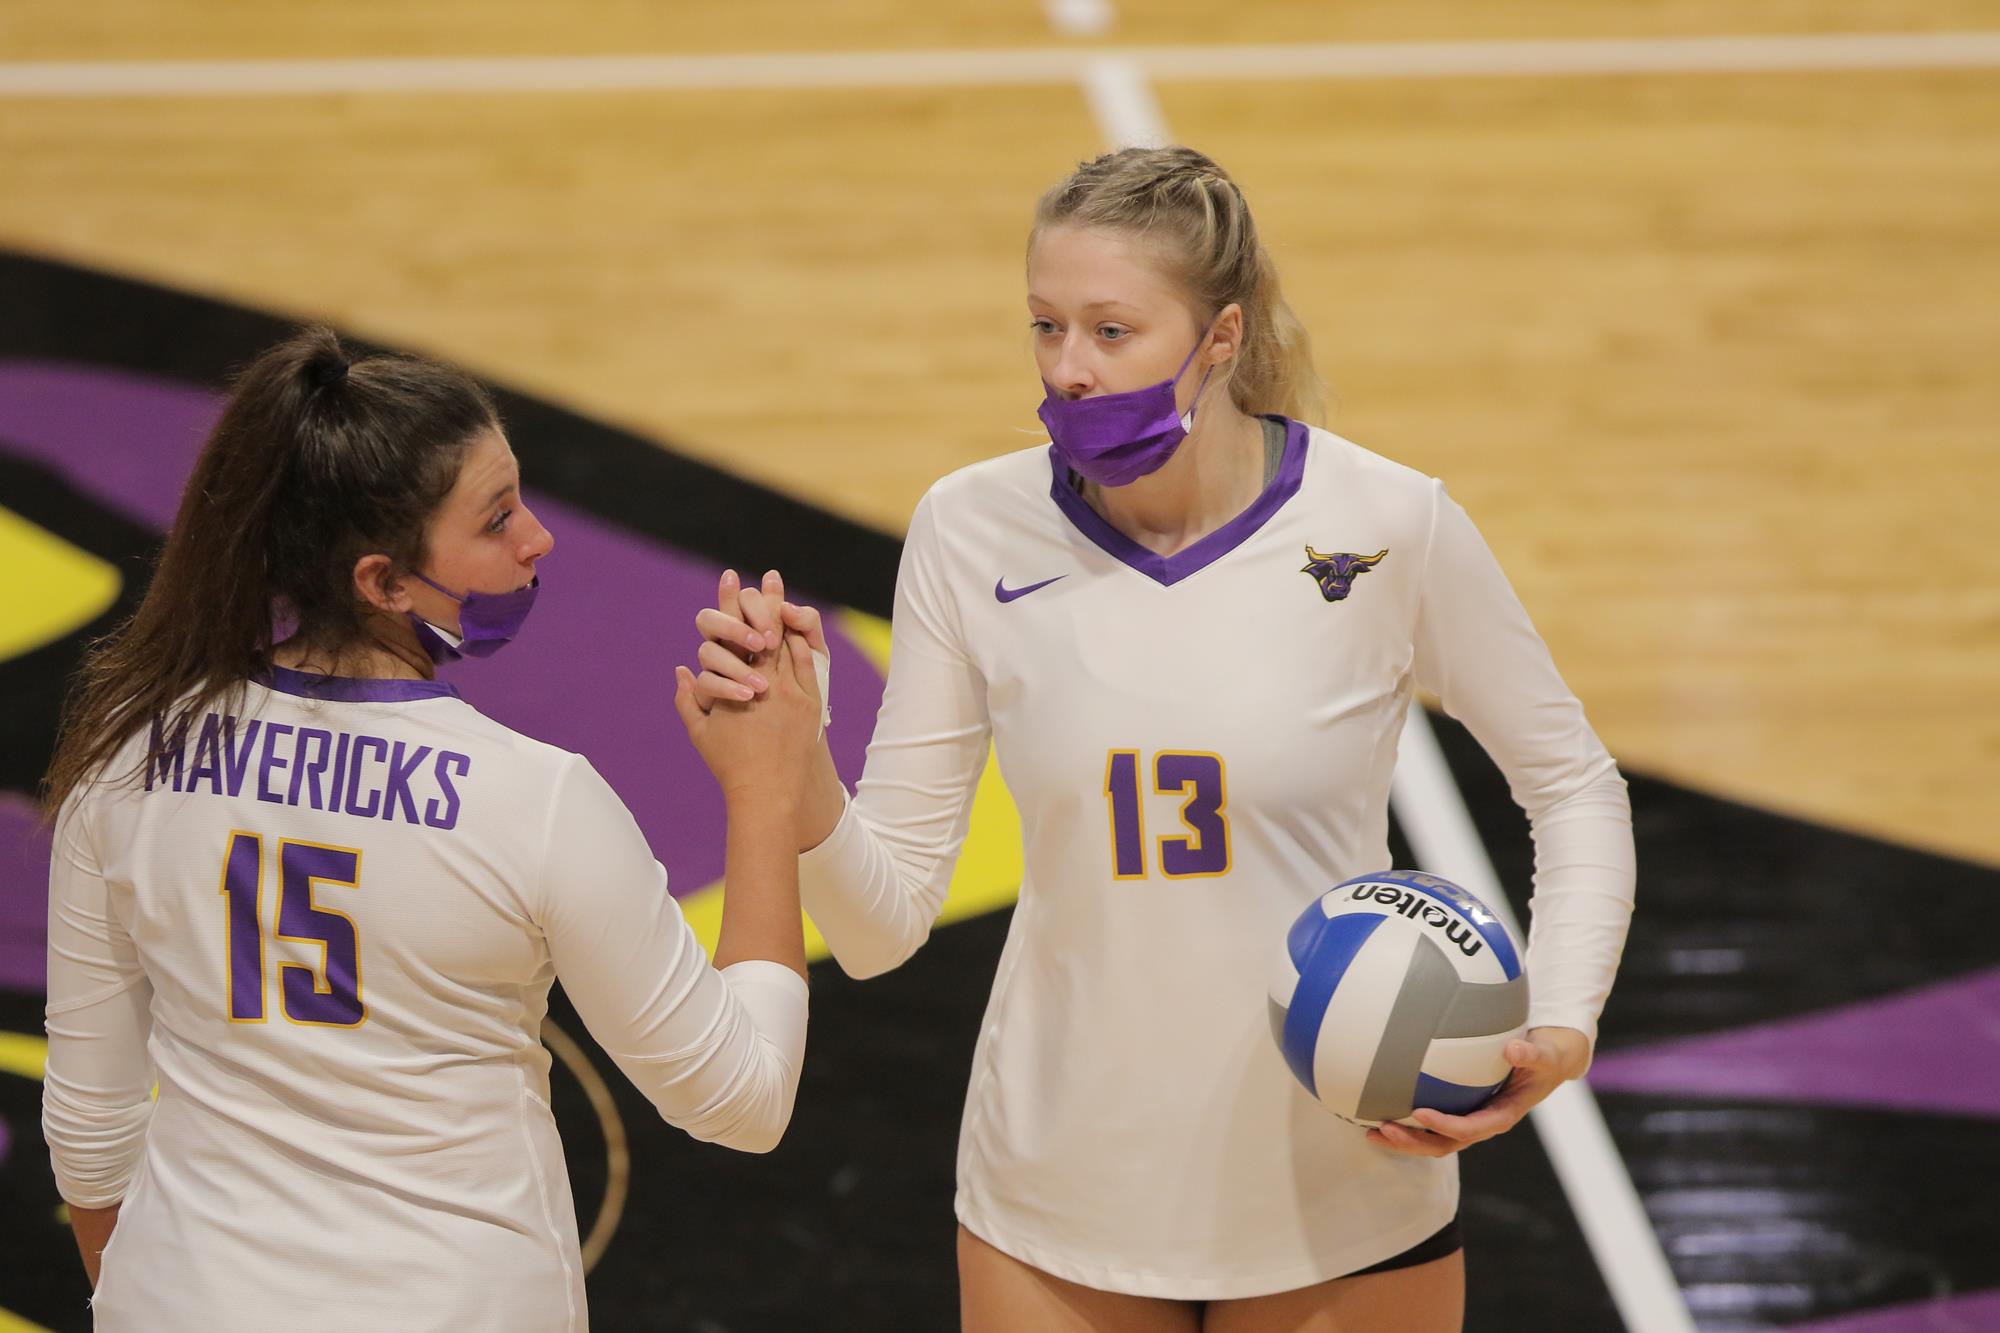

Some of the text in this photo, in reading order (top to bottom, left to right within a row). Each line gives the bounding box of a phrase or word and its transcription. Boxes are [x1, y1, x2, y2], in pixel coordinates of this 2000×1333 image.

[144, 713, 471, 830] MAVERICKS
[1103, 748, 1233, 880] 13
[219, 829, 369, 1029] 15
[1351, 885, 1482, 957] molten
